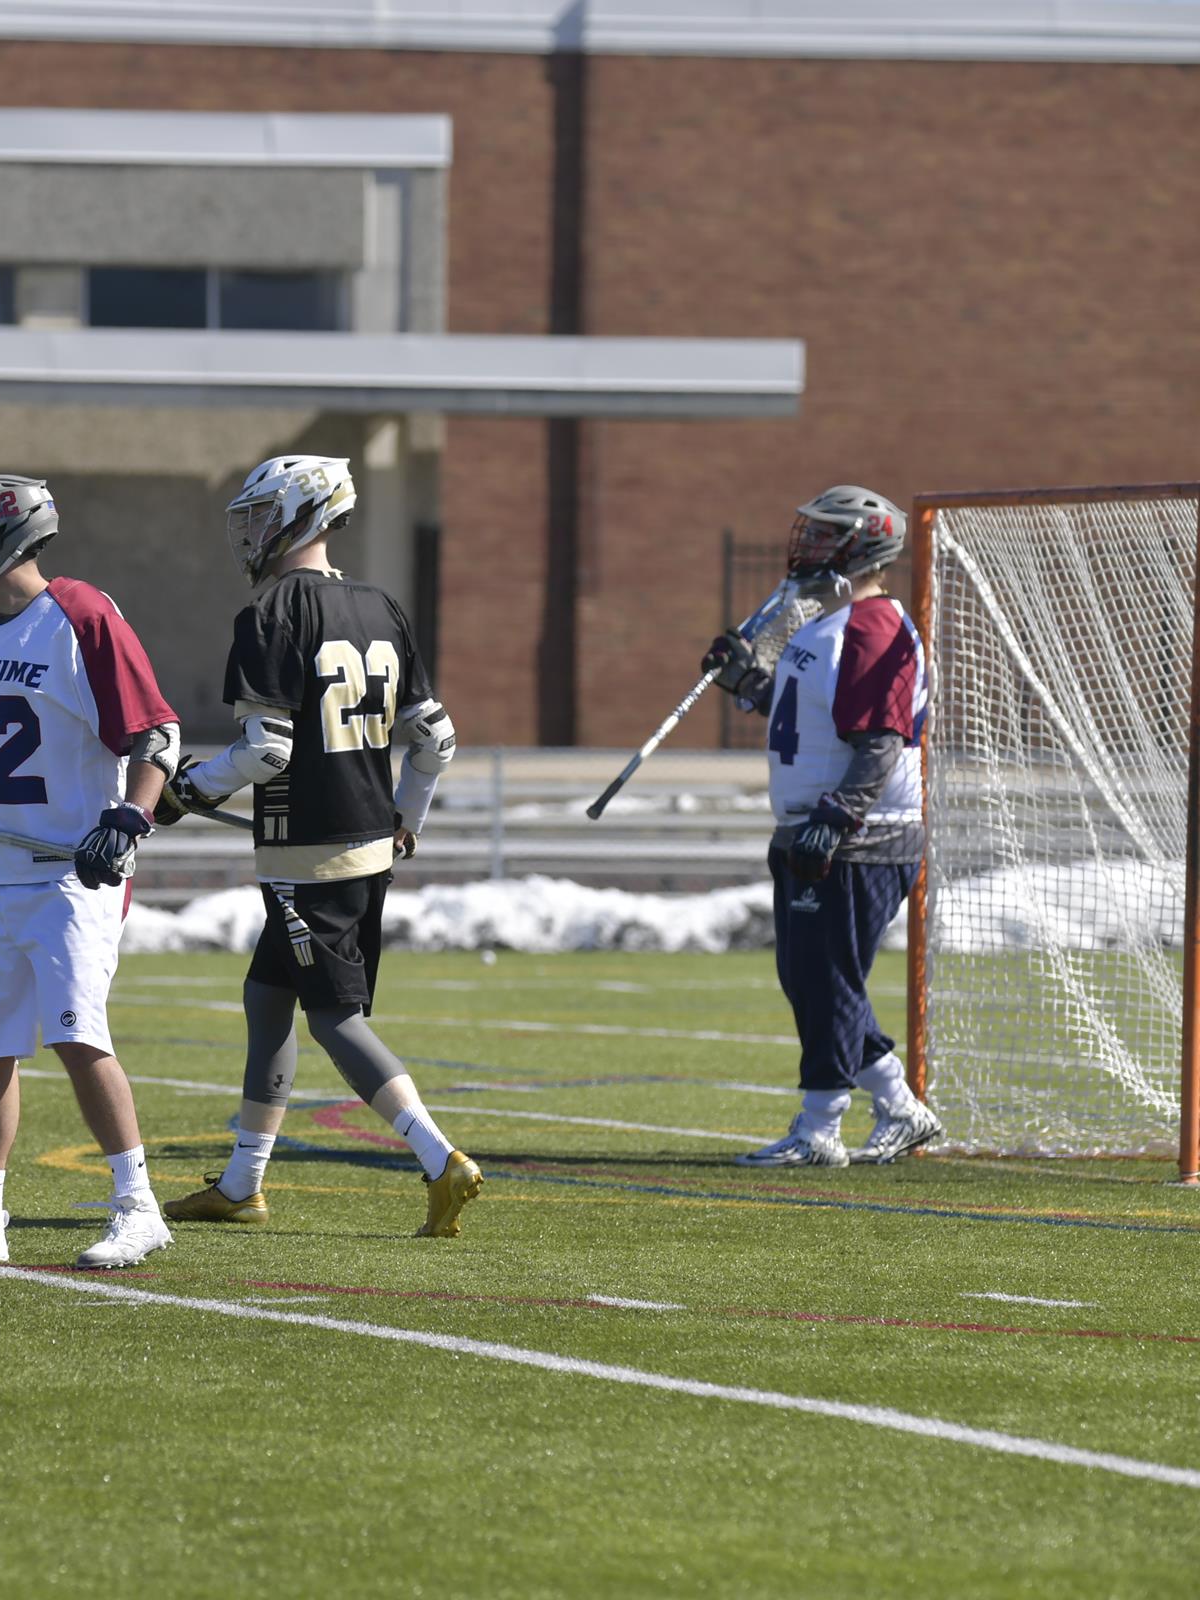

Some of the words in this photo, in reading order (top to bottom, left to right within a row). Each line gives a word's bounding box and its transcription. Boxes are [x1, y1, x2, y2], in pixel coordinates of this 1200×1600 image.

[295, 468, 330, 496] 23
[867, 515, 893, 537] 24
[314, 640, 400, 753] 23
